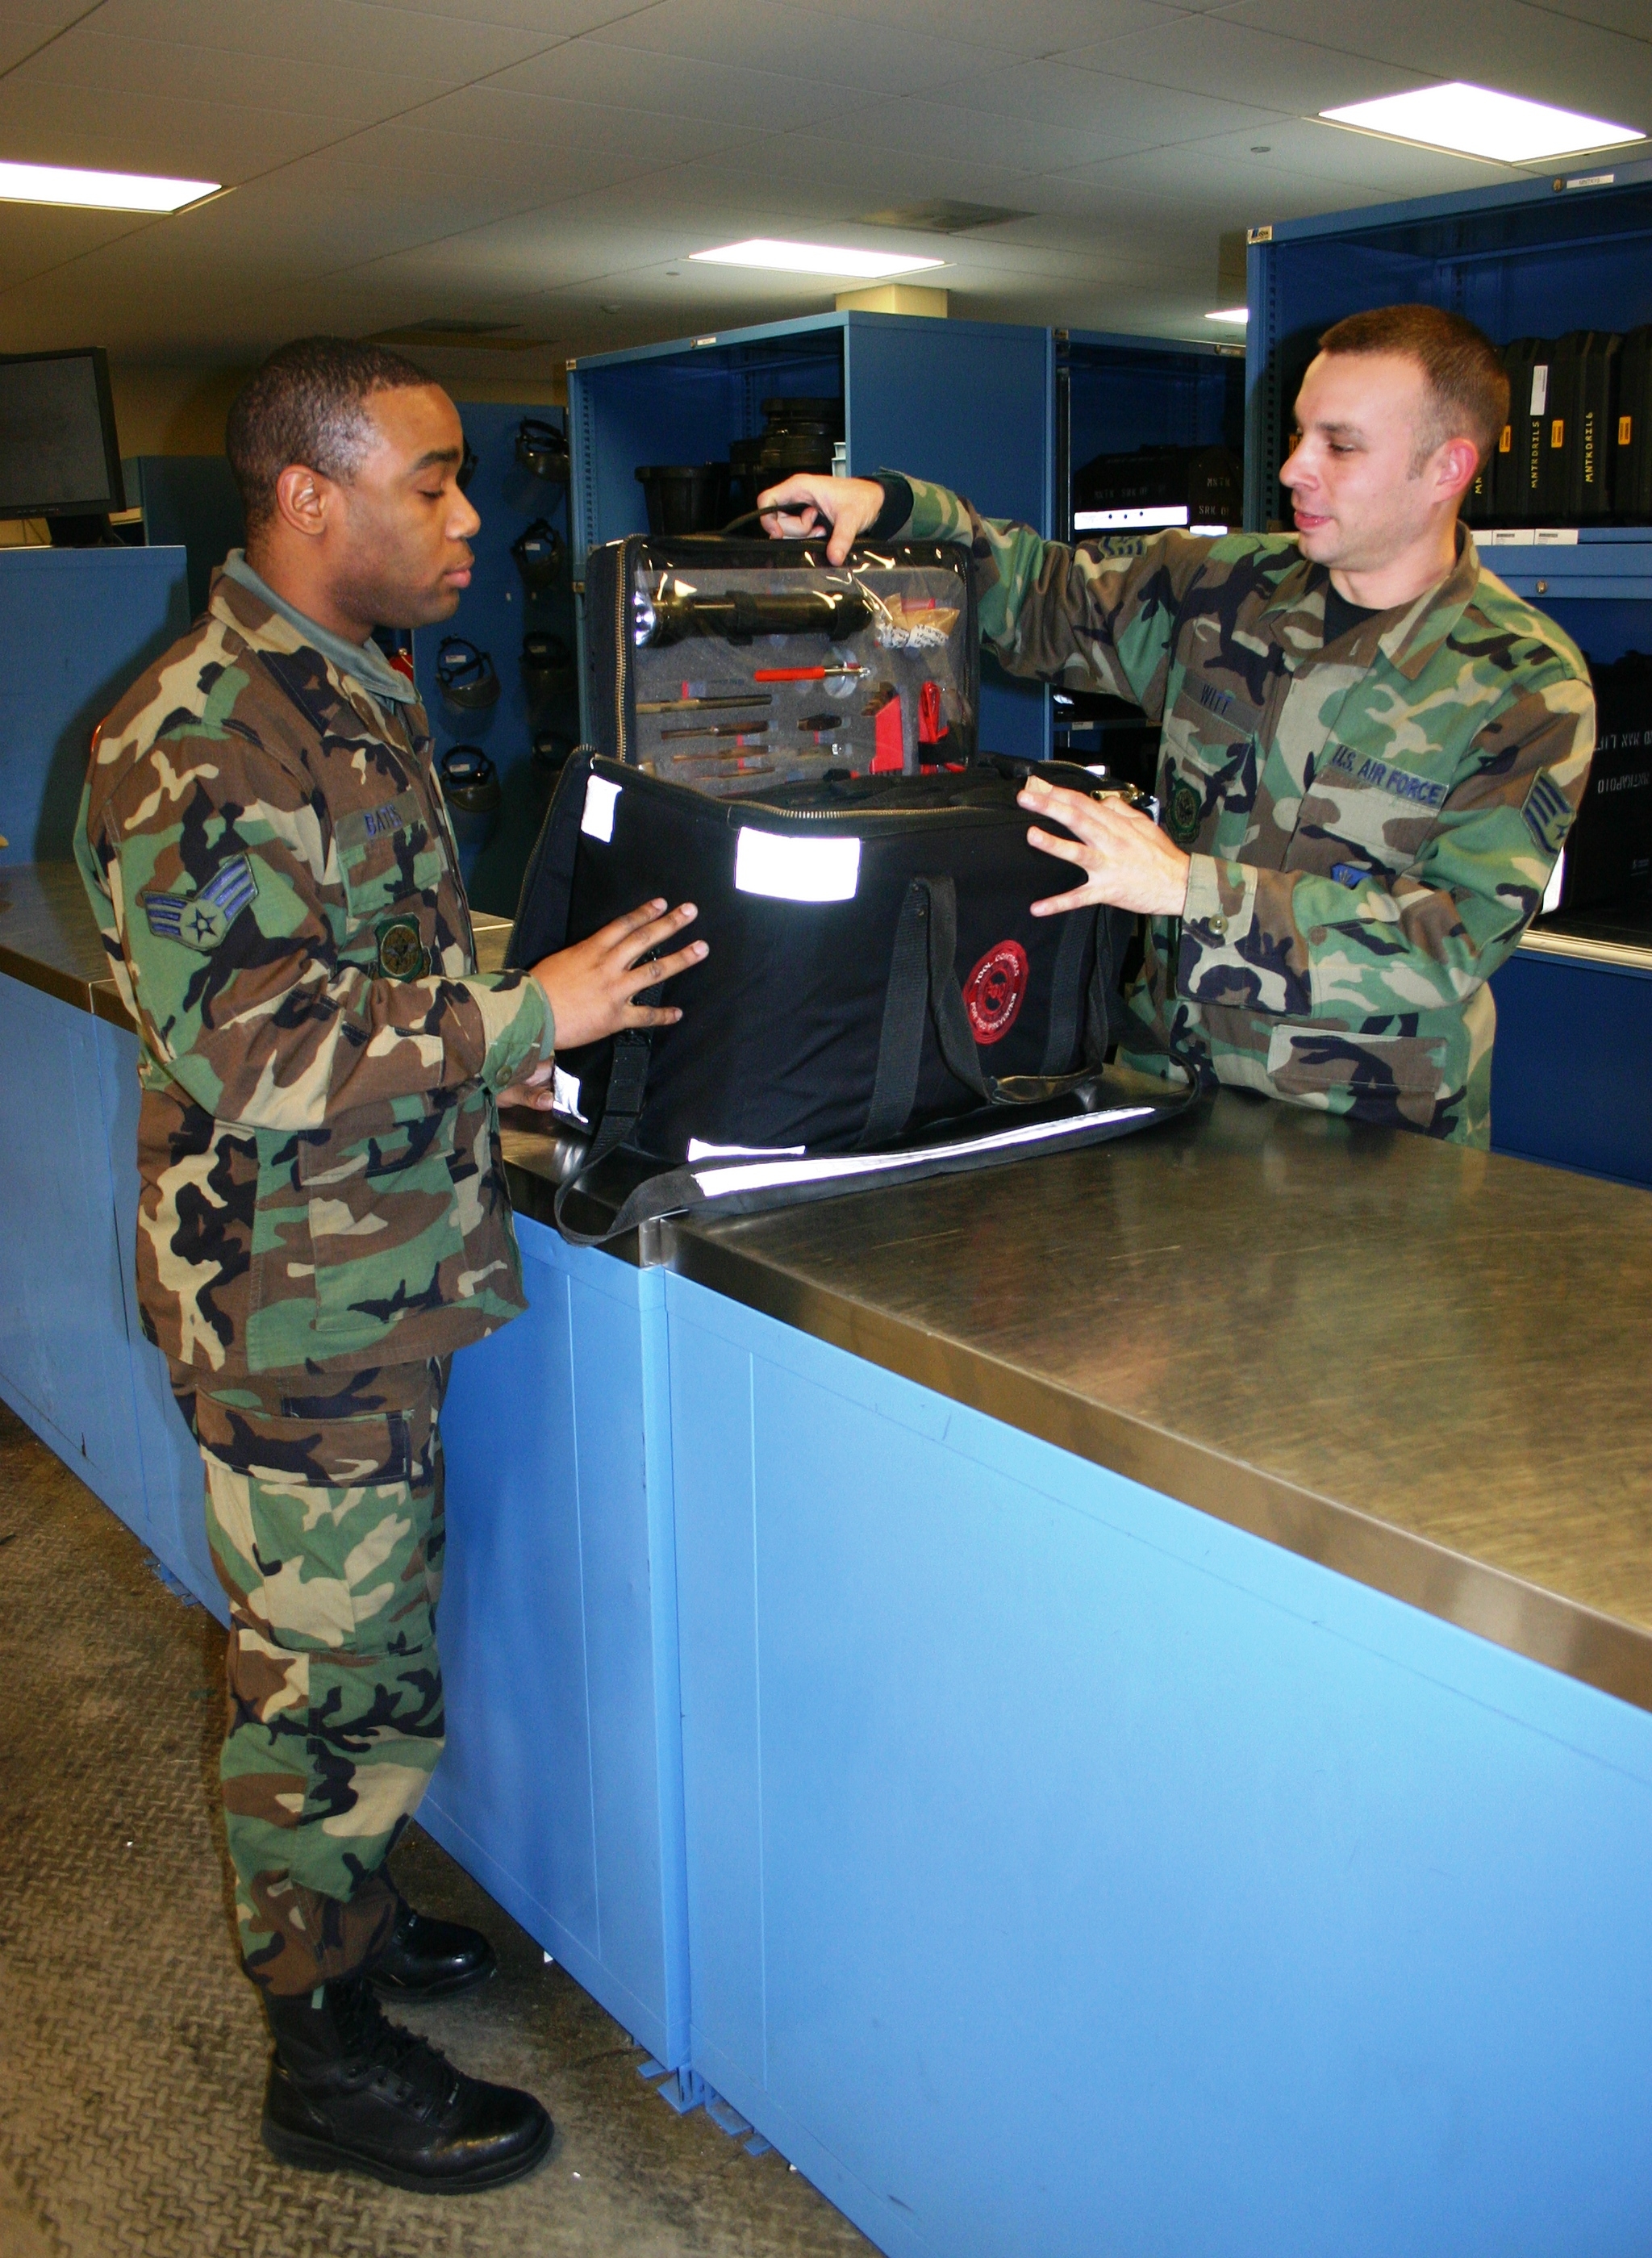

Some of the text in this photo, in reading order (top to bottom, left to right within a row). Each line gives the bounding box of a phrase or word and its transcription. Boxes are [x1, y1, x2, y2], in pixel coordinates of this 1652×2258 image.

[1199, 683, 1233, 716] WITT
[1332, 744, 1444, 804] U.S. AIR FORCE
[974, 962, 993, 984] TOOL
